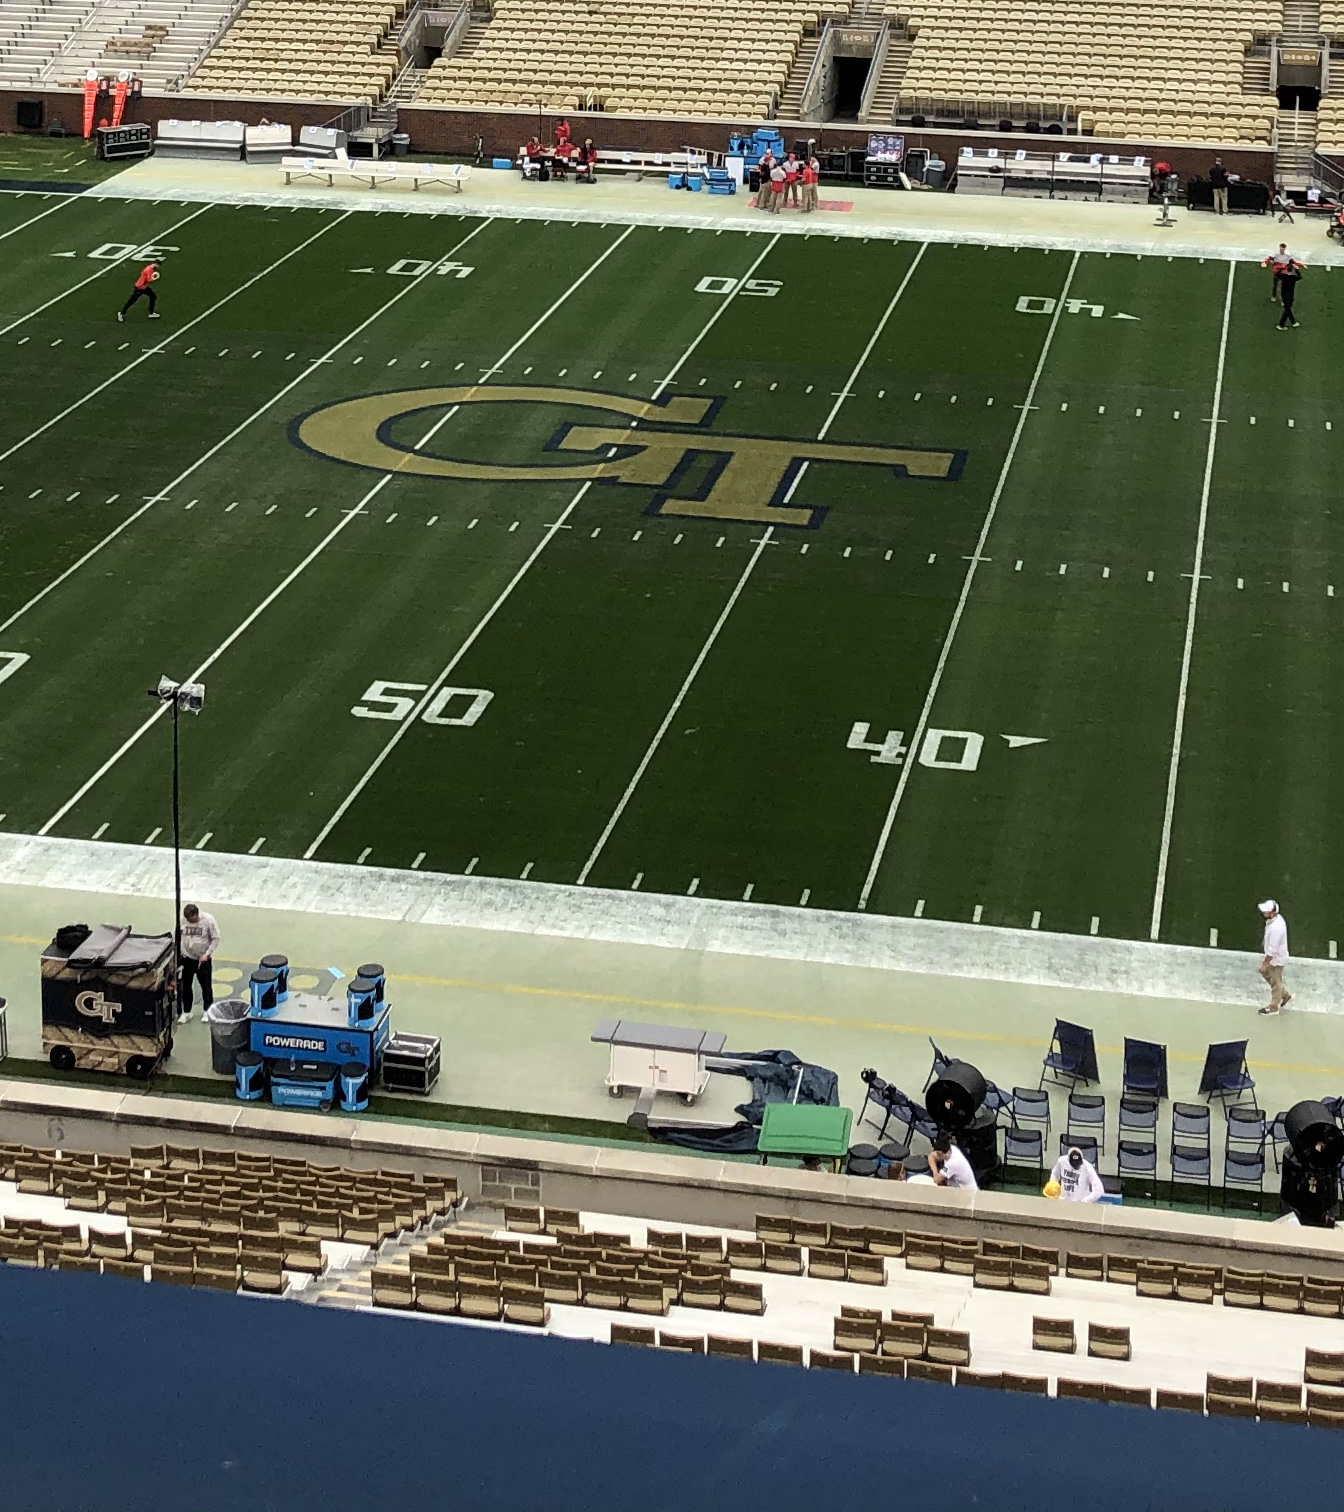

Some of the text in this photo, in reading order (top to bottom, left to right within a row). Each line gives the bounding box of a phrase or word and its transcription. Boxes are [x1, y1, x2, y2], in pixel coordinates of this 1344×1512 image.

[288, 385, 968, 529] GT
[351, 679, 495, 726] 50
[845, 721, 985, 772] 40
[74, 989, 122, 1024] GT
[265, 1036, 325, 1051] POWERADE
